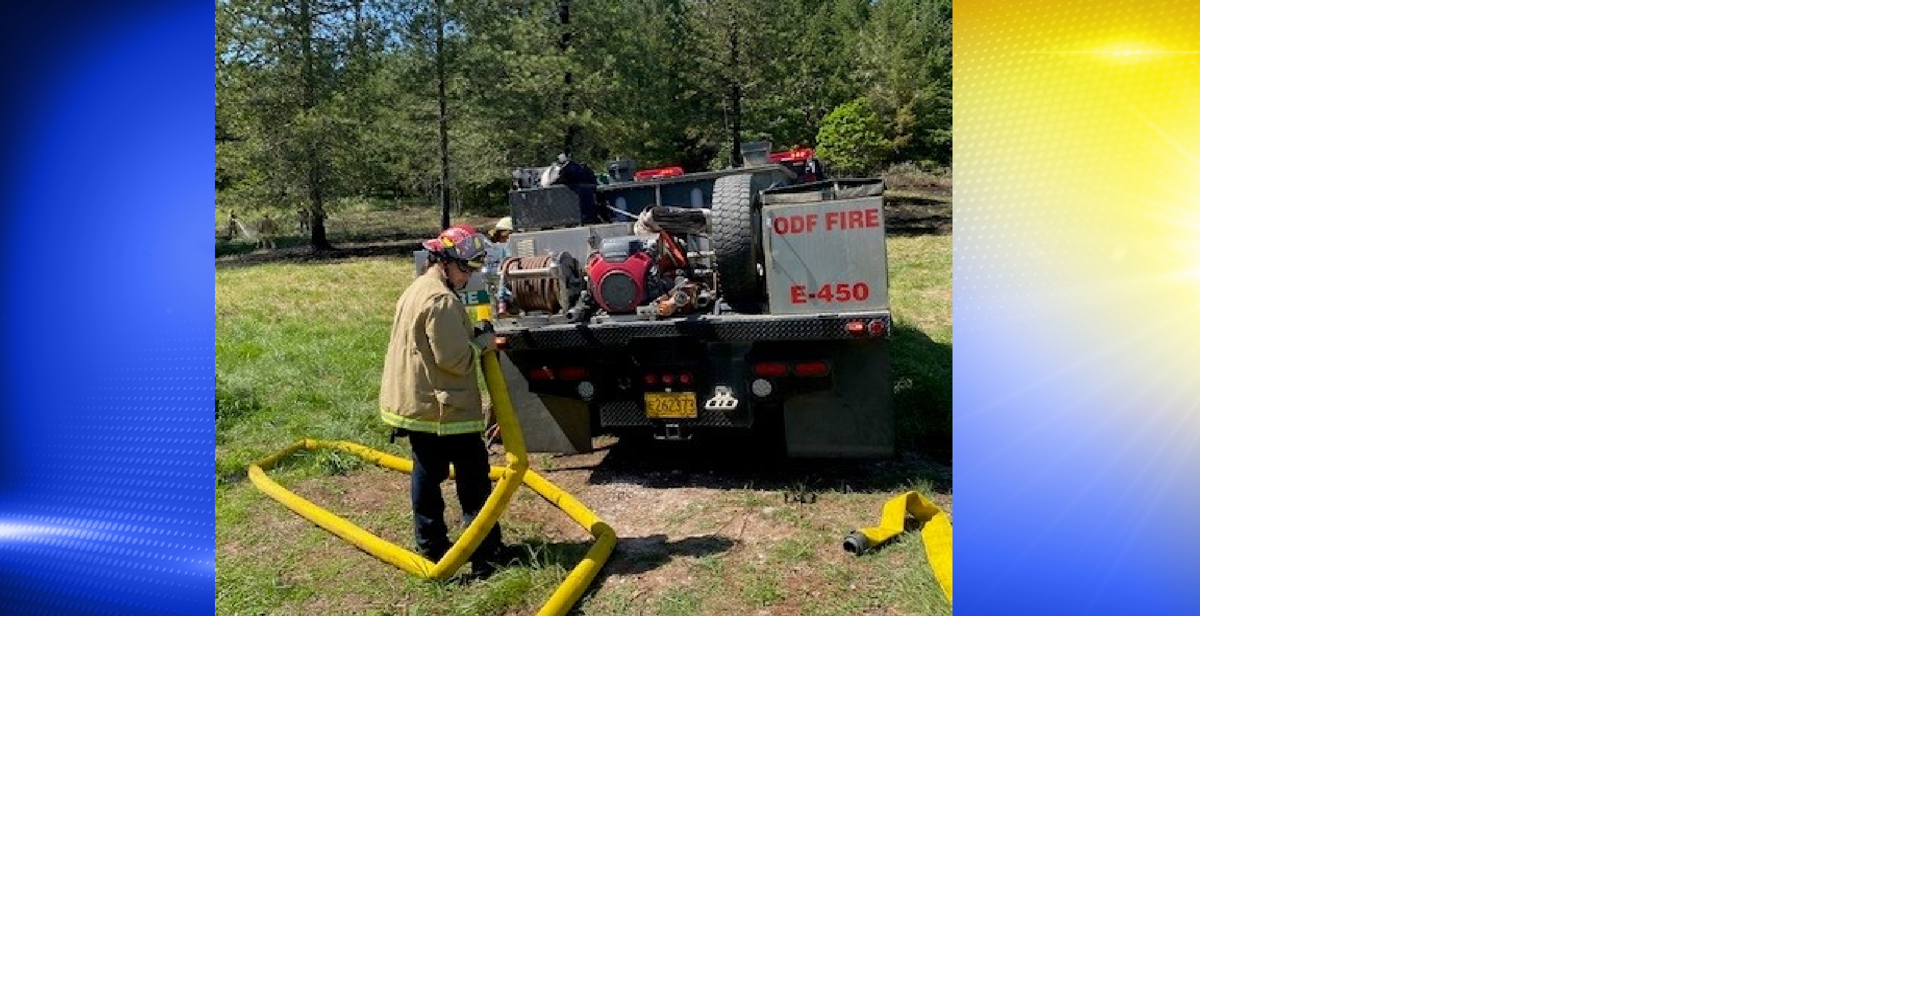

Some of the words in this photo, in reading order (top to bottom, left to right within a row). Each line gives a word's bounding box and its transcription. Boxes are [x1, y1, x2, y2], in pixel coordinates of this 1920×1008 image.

[774, 215, 818, 235] ODF
[826, 208, 879, 231] FIRE
[790, 281, 870, 304] E-450
